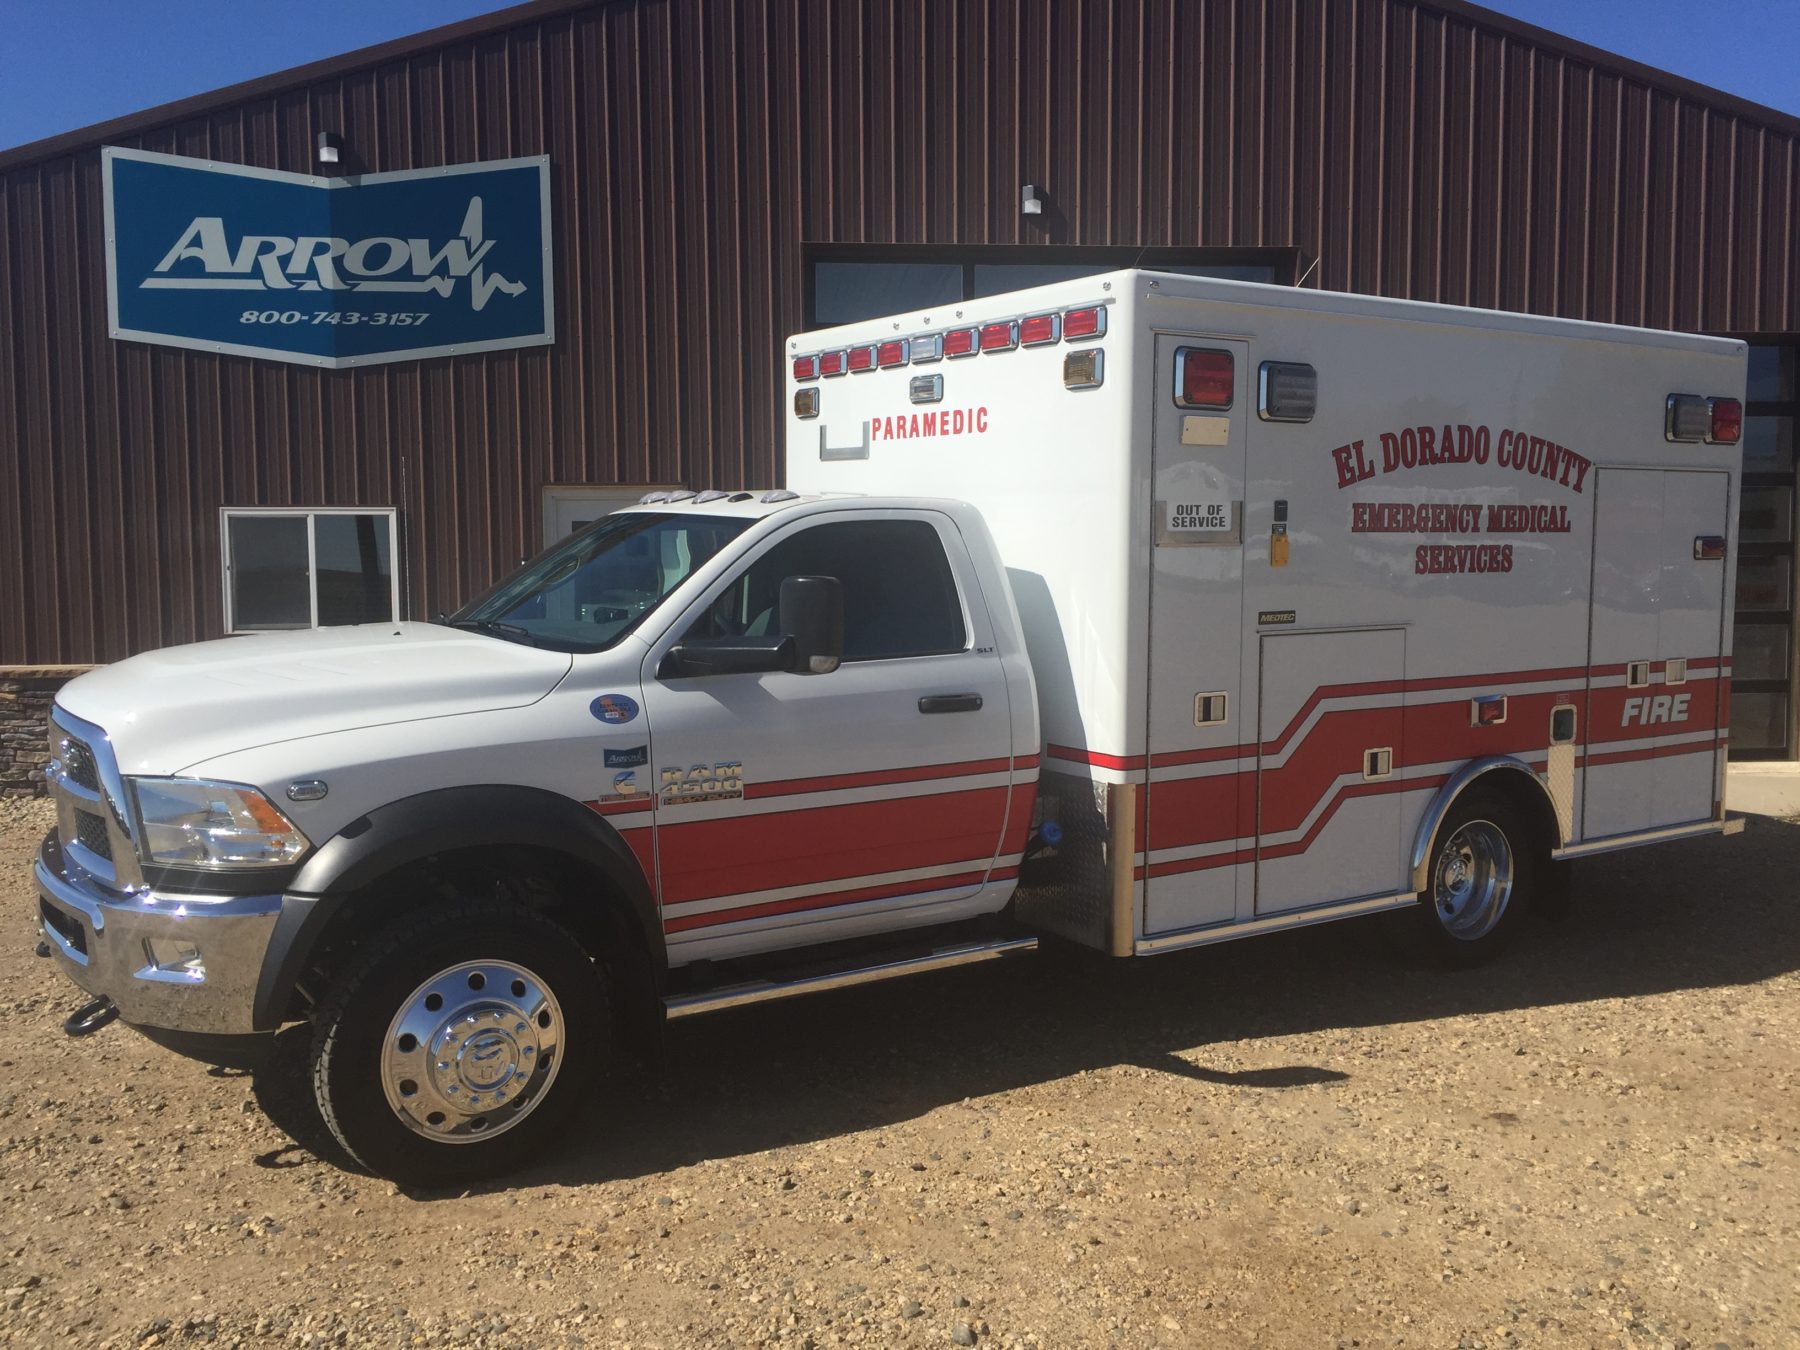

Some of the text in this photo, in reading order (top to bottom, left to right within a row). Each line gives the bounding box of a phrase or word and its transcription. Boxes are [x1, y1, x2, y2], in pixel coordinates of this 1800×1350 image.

[153, 216, 497, 290] ARROW
[239, 310, 429, 326] 800-743-3157
[871, 406, 988, 441] PARAMEDIC
[1331, 424, 1592, 494] EL DORADO COUNTY
[1172, 516, 1226, 528] SERVICE
[1176, 504, 1223, 516] OUT OF
[1351, 503, 1571, 533] EMERGENCY MEDICAL
[1415, 544, 1514, 574] SERVICES
[976, 646, 994, 654] SLT
[1621, 693, 1691, 727] FIRE
